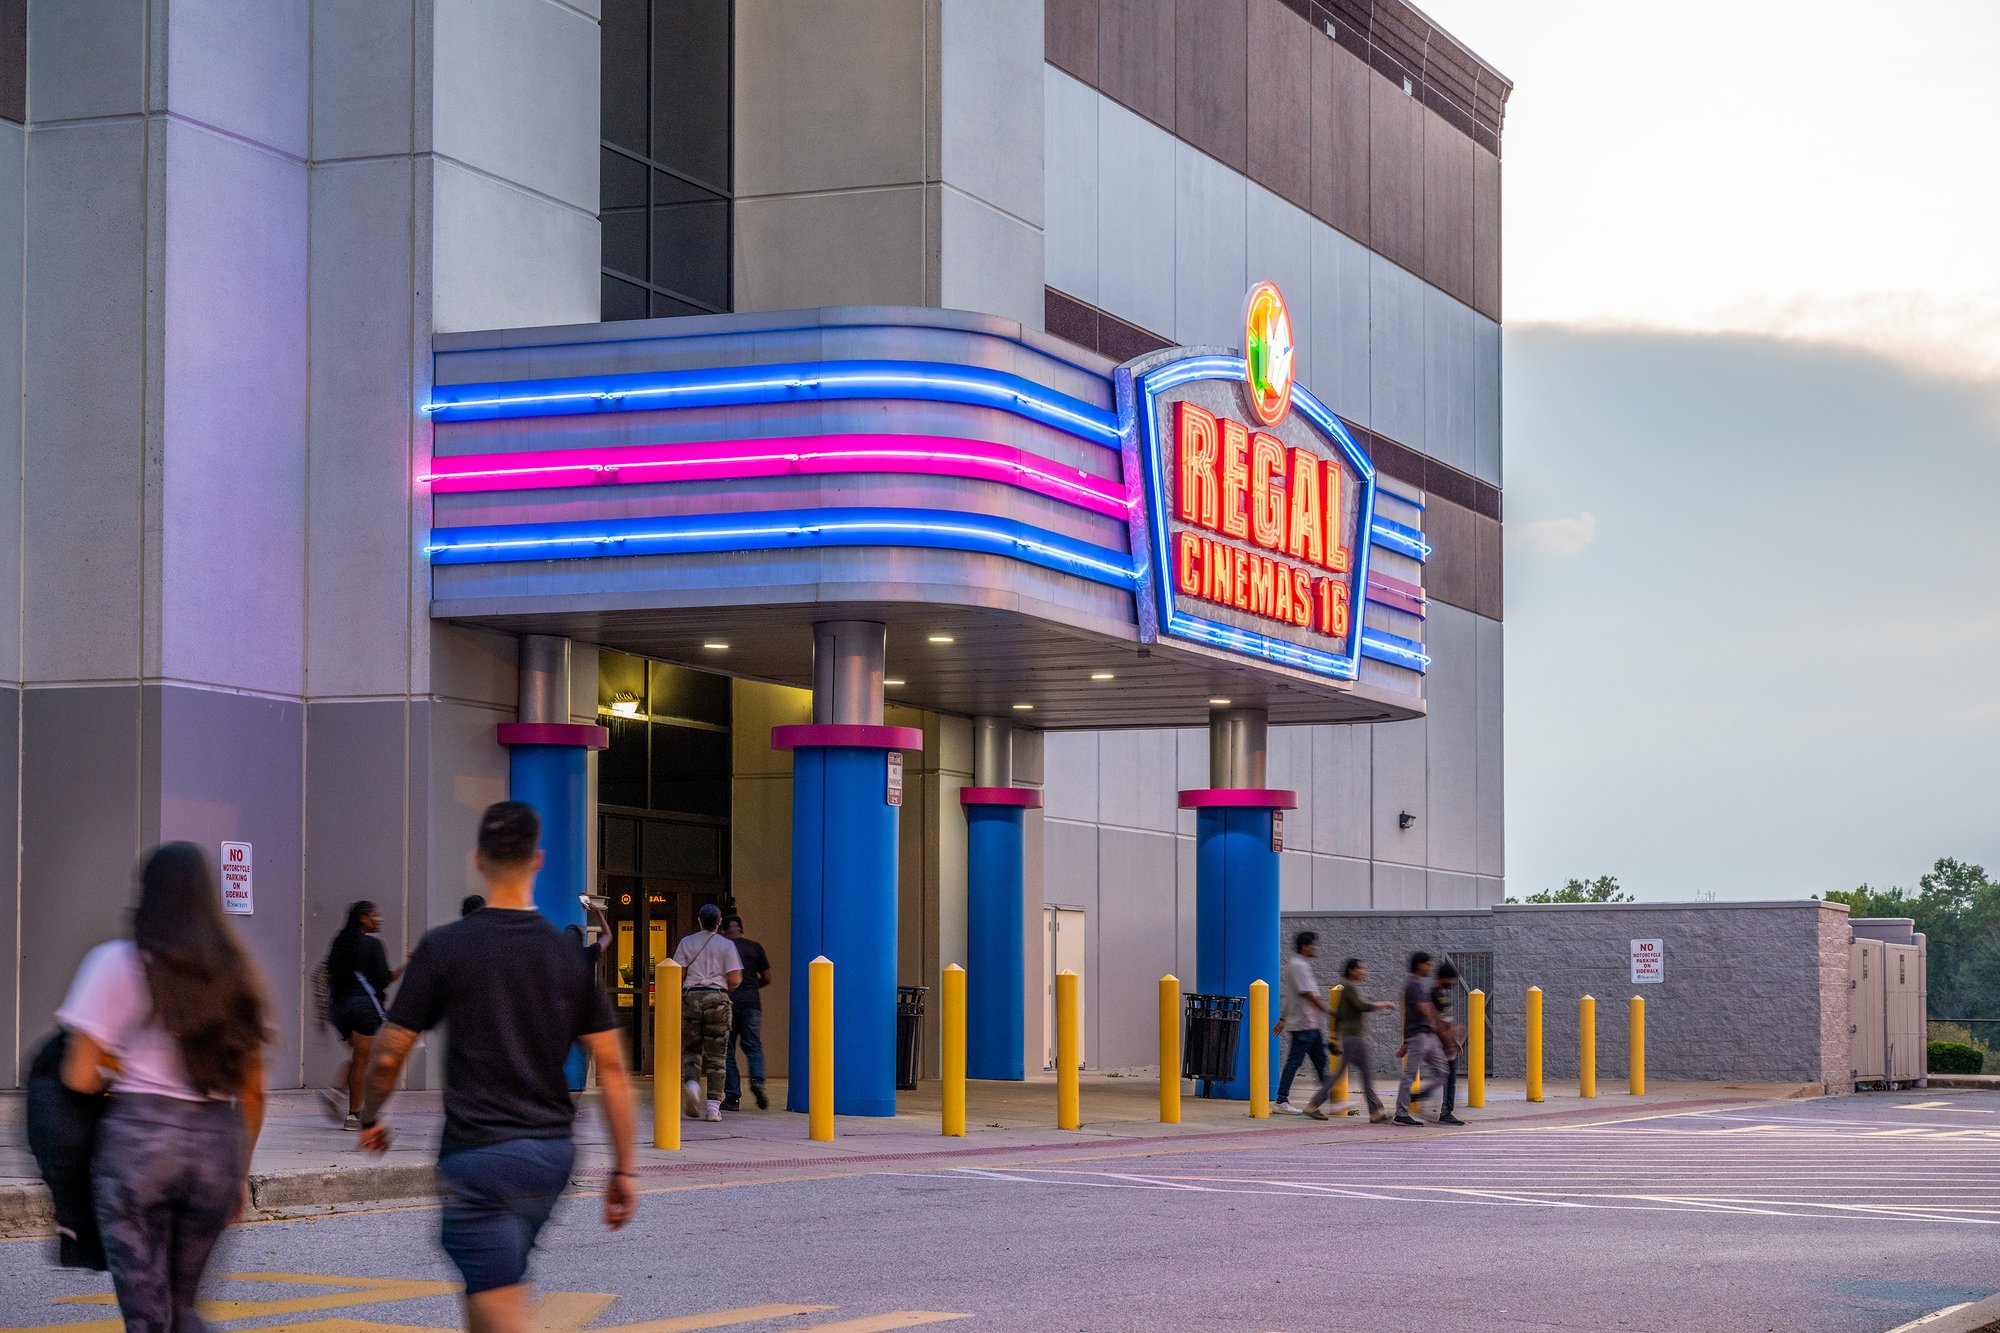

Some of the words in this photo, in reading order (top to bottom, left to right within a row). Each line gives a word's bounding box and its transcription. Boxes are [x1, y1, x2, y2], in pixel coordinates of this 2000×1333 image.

[1174, 401, 1348, 573] REGAL
[1173, 531, 1312, 627] CINEMAS
[1312, 576, 1348, 638] 16
[223, 864, 250, 872] MOTORCYCLE
[230, 849, 243, 862] NO
